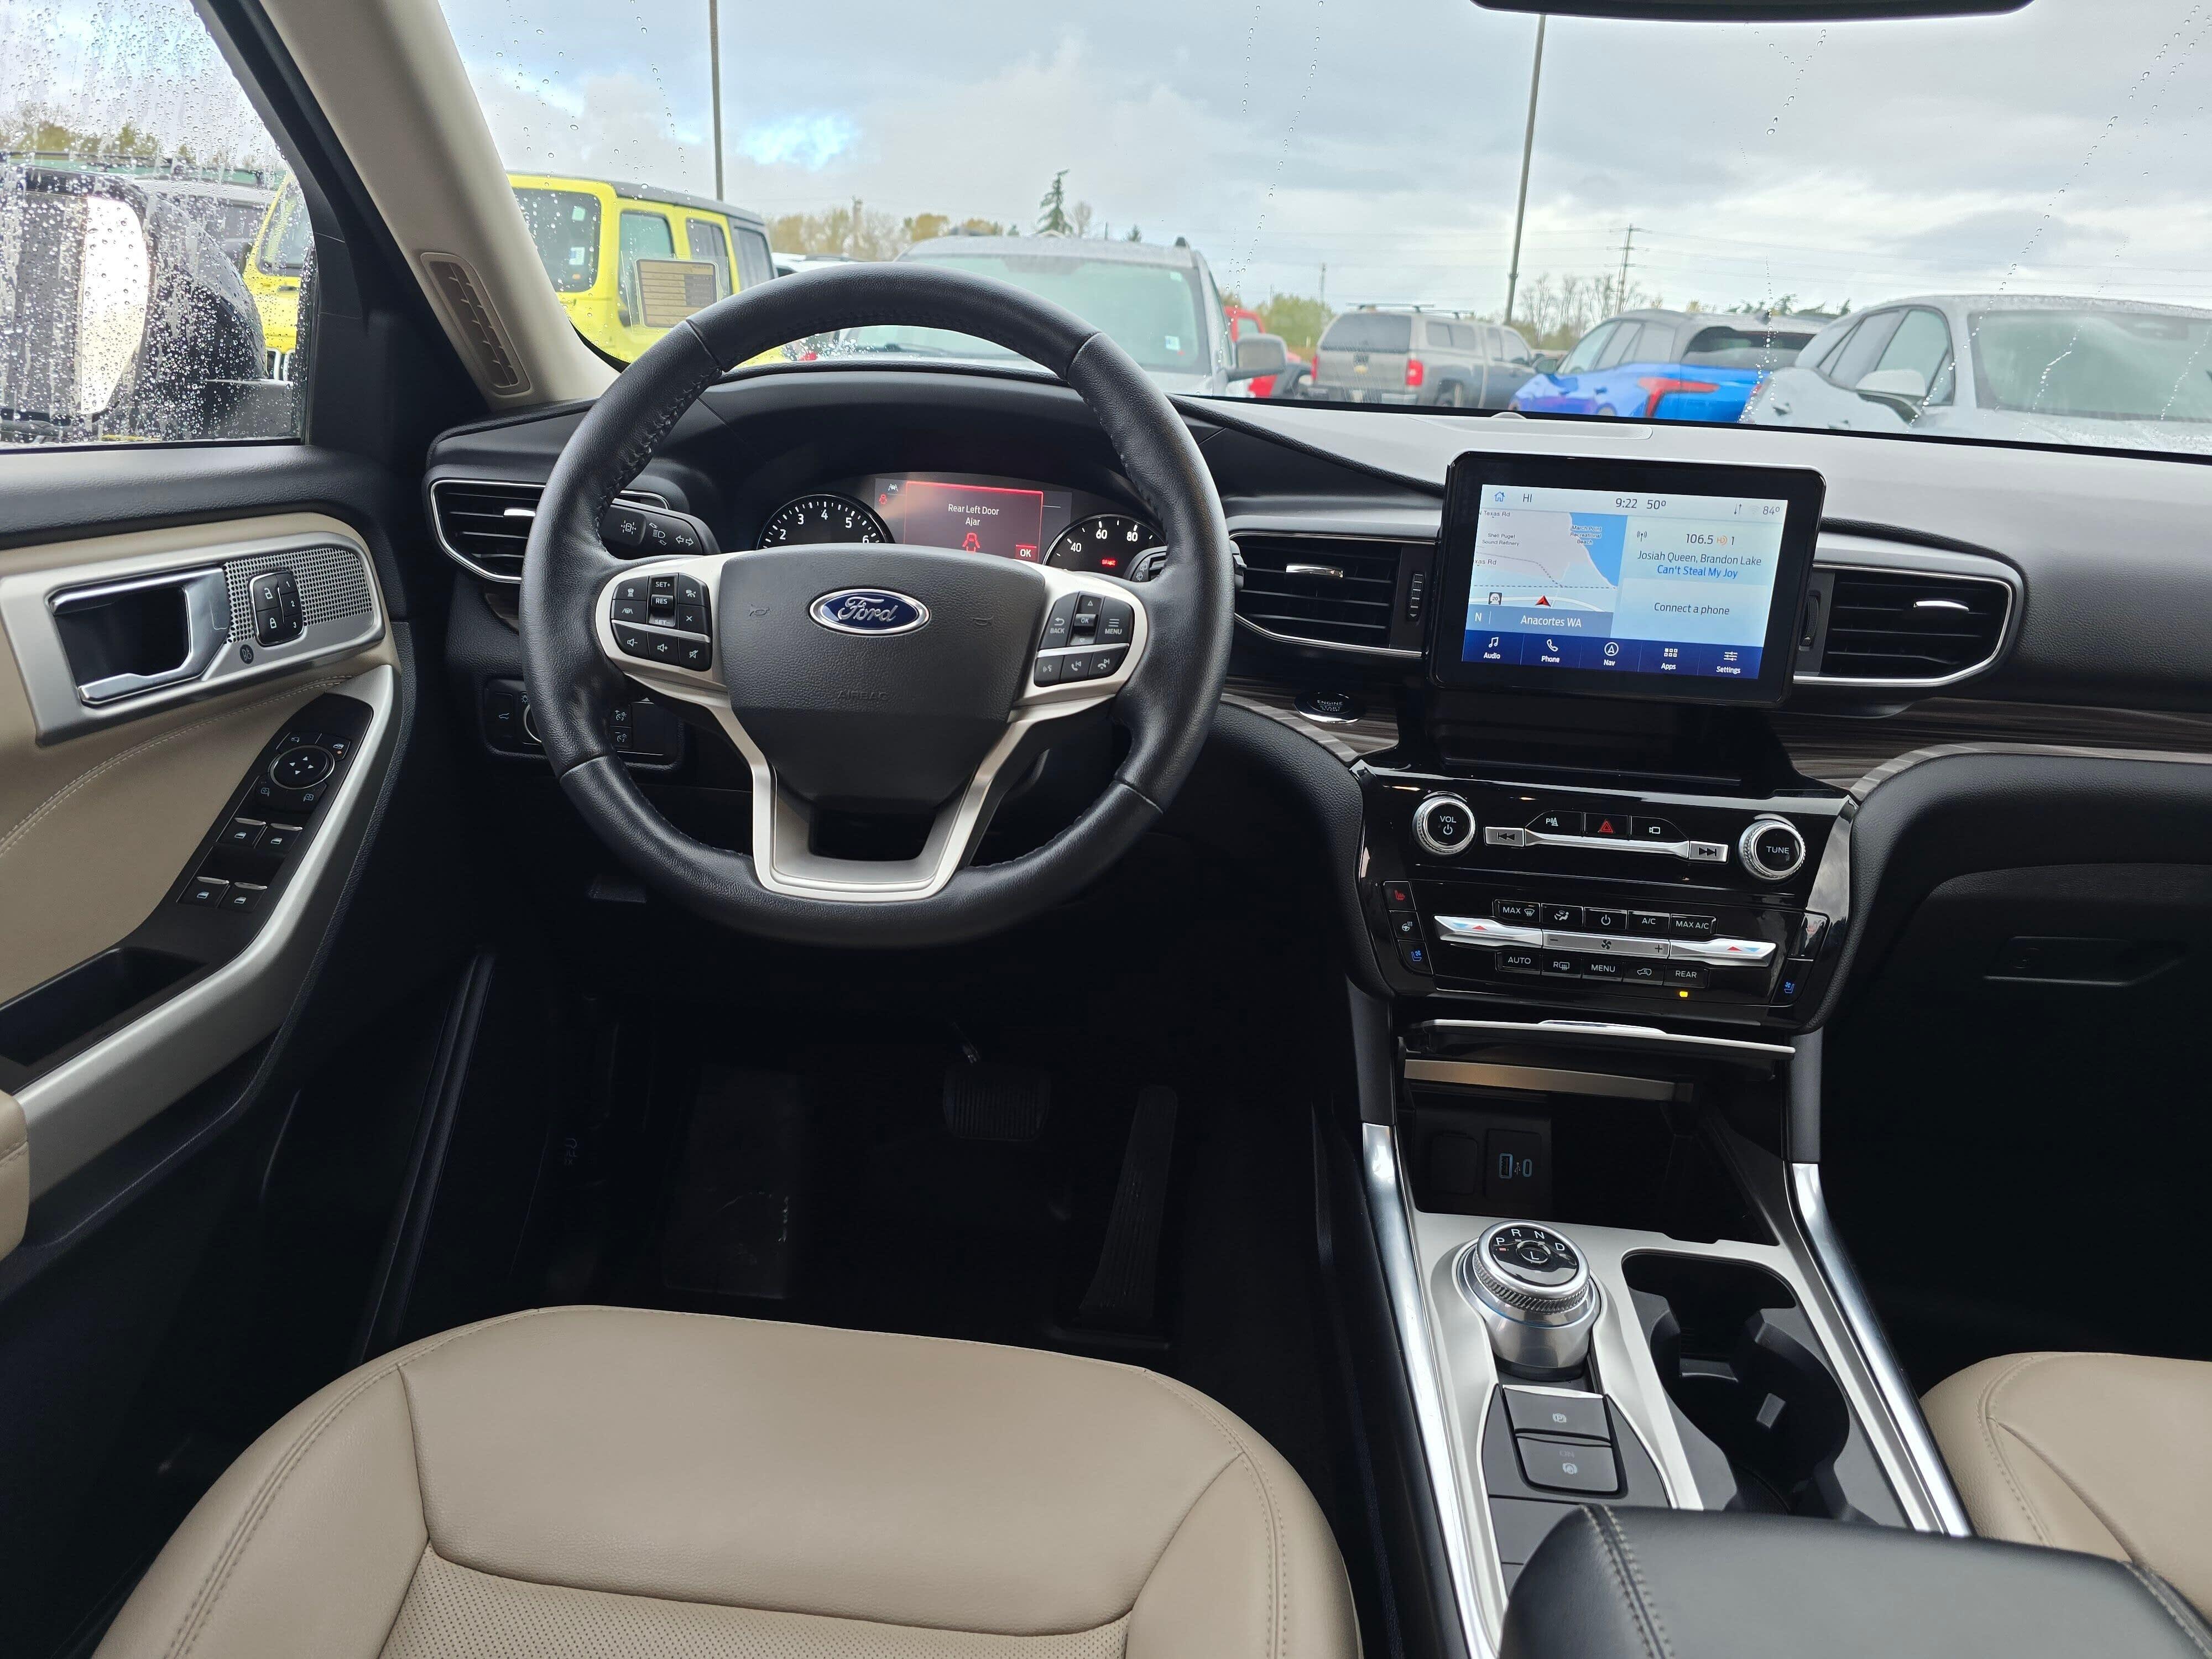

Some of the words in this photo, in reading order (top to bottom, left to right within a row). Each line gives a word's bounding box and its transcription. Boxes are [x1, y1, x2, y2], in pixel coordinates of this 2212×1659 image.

[1522, 493, 1532, 503] HI
[1615, 498, 1638, 509] 9:22
[948, 503, 965, 513] Rear
[966, 505, 980, 514] Left
[982, 506, 999, 515] Door
[797, 514, 804, 525] 3
[821, 509, 828, 520] 4
[845, 517, 852, 528] 5
[965, 517, 980, 526] Ajar
[779, 529, 786, 540] 2
[862, 535, 869, 544] 6
[1095, 529, 1108, 540] 60
[1126, 531, 1138, 542] 80
[1686, 534, 1714, 545] 106.5
[1070, 542, 1082, 552] 40
[1020, 549, 1031, 557] OK
[1637, 550, 1665, 561] Josiah
[1667, 552, 1698, 564] Queen,
[1700, 554, 1738, 565] Brandon
[1740, 556, 1762, 566] Lake
[1657, 565, 1681, 575] Can't
[1683, 566, 1706, 576] Steal
[1708, 568, 1721, 578] My
[1723, 569, 1738, 580] Joy
[837, 596, 899, 623] Ford
[1653, 602, 1691, 613] Connect
[1700, 605, 1730, 615] phone
[1474, 612, 1482, 622] N
[1520, 615, 1564, 627] Anacortes
[1567, 618, 1582, 628] WA
[1661, 662, 1676, 671] Apps
[1716, 666, 1741, 675] Settings
[1766, 846, 1790, 854] TUNE
[1676, 920, 1694, 928] MAX
[1507, 956, 1531, 964] AUTO
[1591, 964, 1615, 973] MENU
[1675, 970, 1697, 978] REAR
[1511, 1229, 1522, 1237] R
[1533, 1230, 1545, 1239] N
[1496, 1237, 1505, 1245] P
[1554, 1243, 1566, 1251] D
[1530, 1251, 1540, 1260] L
